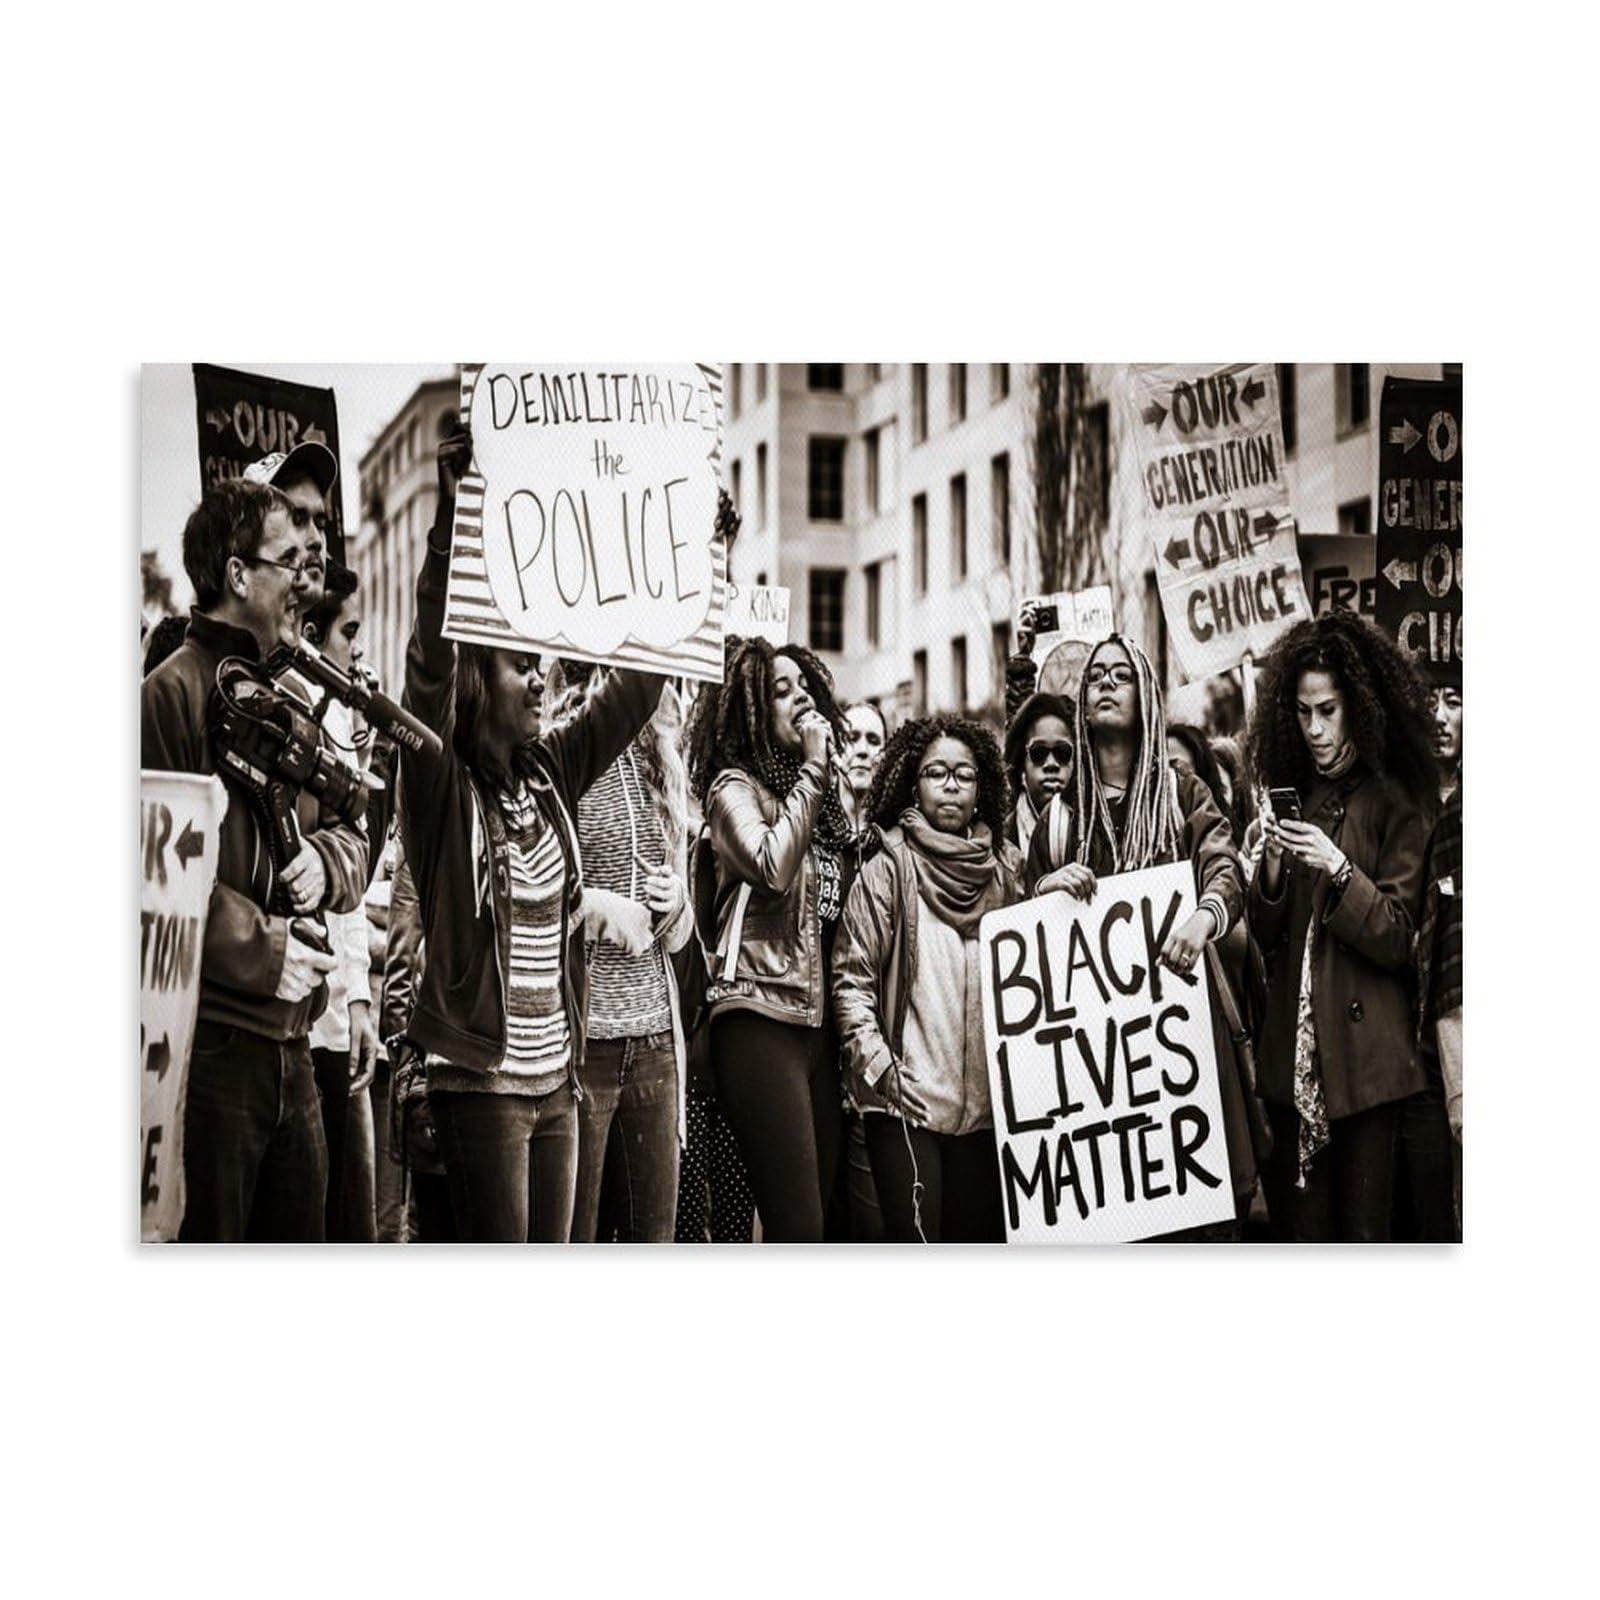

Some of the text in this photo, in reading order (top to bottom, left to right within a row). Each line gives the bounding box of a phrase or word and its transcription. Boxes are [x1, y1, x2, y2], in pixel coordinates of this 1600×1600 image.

[233, 401, 299, 453] OUR
[487, 371, 719, 432] DEMILITARIZE
[1171, 374, 1241, 435] OUR
[591, 438, 630, 480] the
[1147, 433, 1279, 511] GENERATION
[502, 478, 701, 612] POLICE
[1193, 508, 1255, 568] OUR
[1187, 564, 1296, 643] CHOICE
[141, 800, 173, 886] R
[989, 889, 1199, 1037] BLACK
[996, 1003, 1200, 1135] LIVES
[141, 1123, 163, 1206] E
[1001, 1104, 1223, 1231] MATTER
